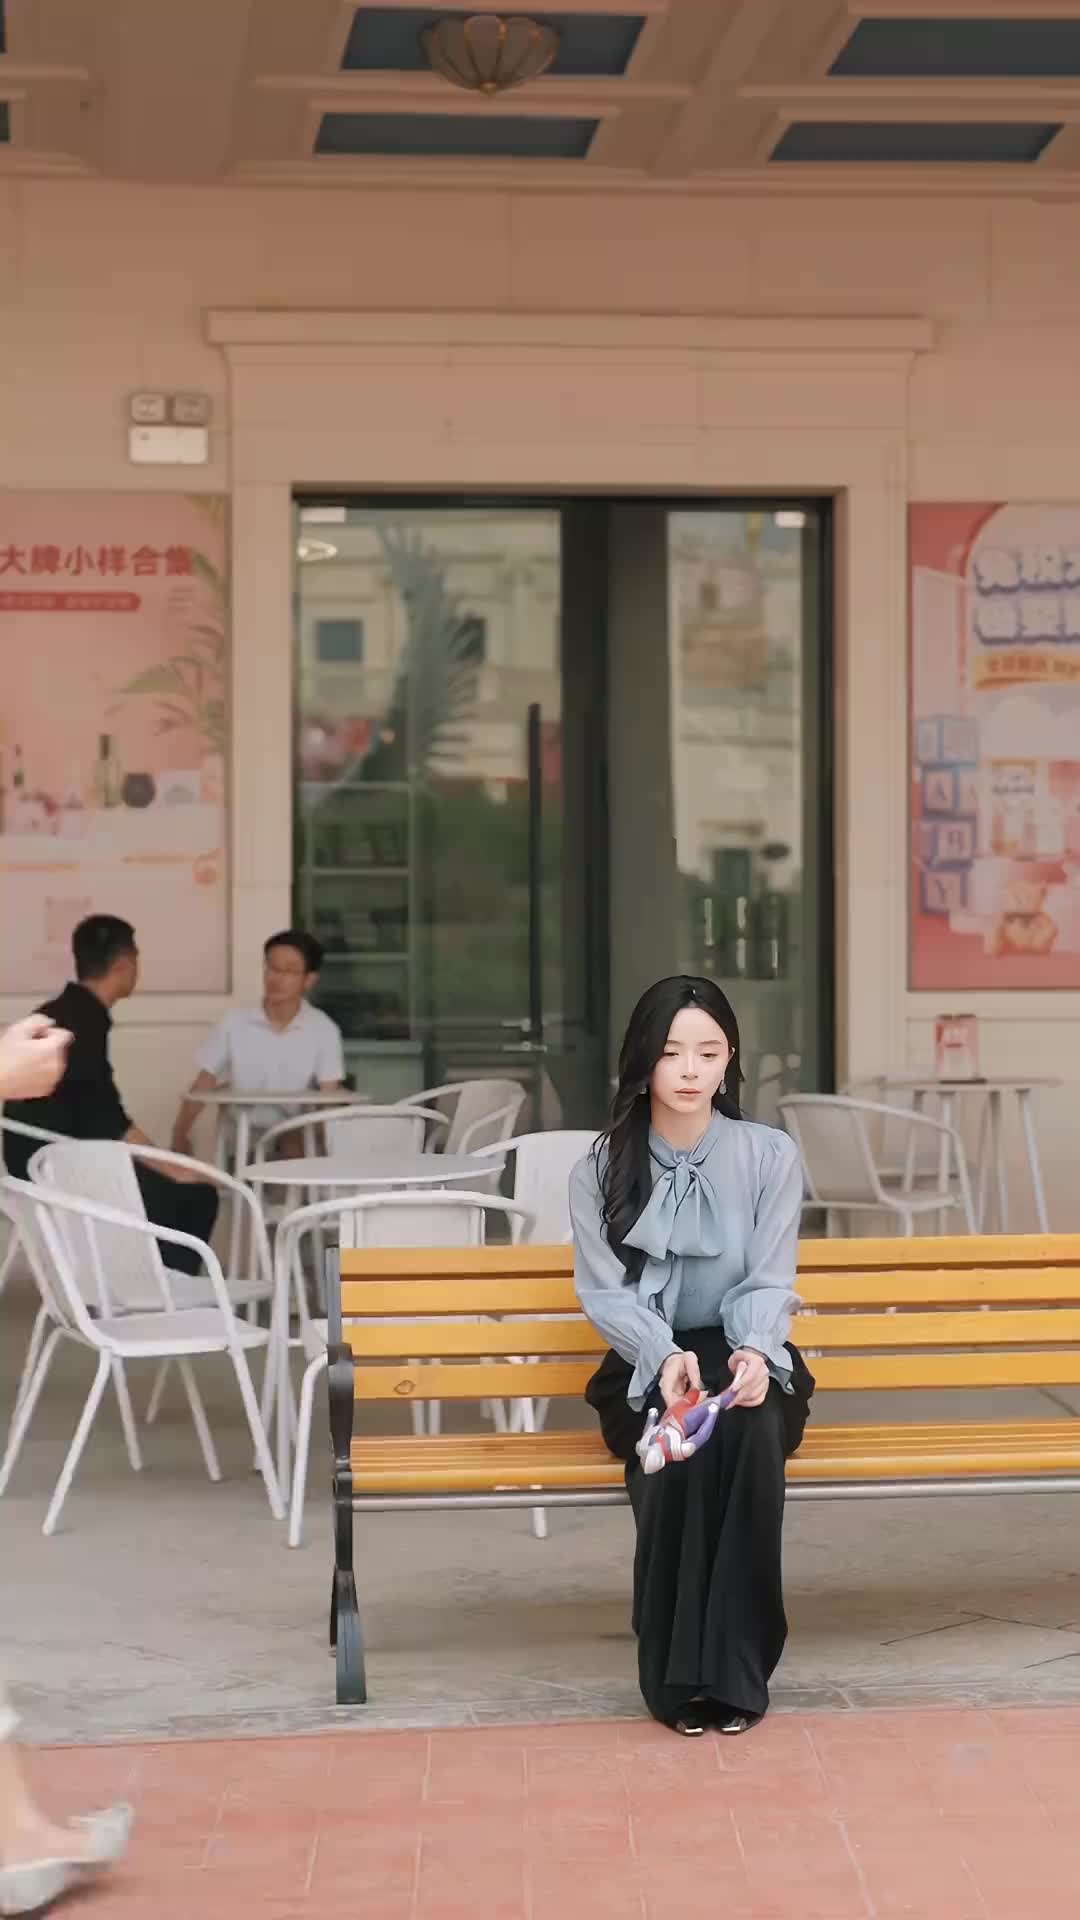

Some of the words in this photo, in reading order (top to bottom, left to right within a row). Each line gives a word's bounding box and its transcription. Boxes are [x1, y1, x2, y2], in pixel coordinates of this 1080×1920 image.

[0, 544, 192, 576] 大牌小样合集
